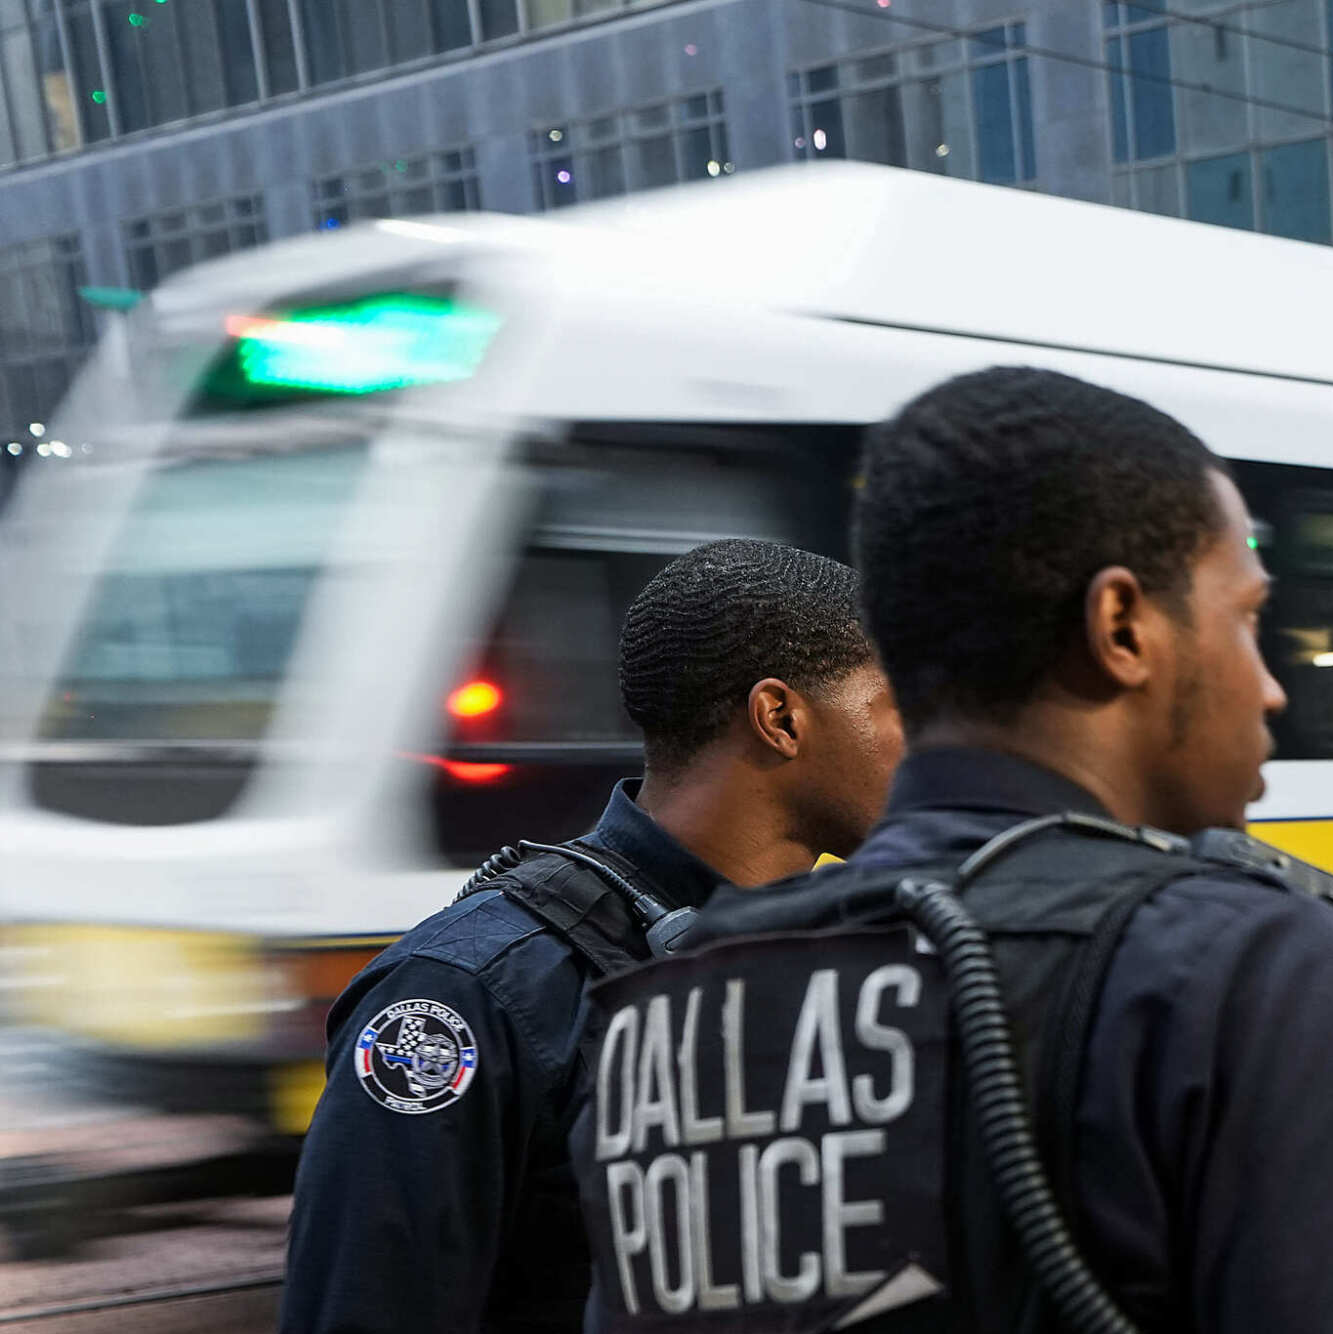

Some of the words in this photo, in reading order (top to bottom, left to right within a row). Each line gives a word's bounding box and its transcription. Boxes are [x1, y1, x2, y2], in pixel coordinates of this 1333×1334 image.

[386, 1003, 429, 1019] DALLAS
[430, 1005, 464, 1032] POLICE
[595, 963, 922, 1161] DALLAS
[606, 1128, 889, 1316] POLICE
